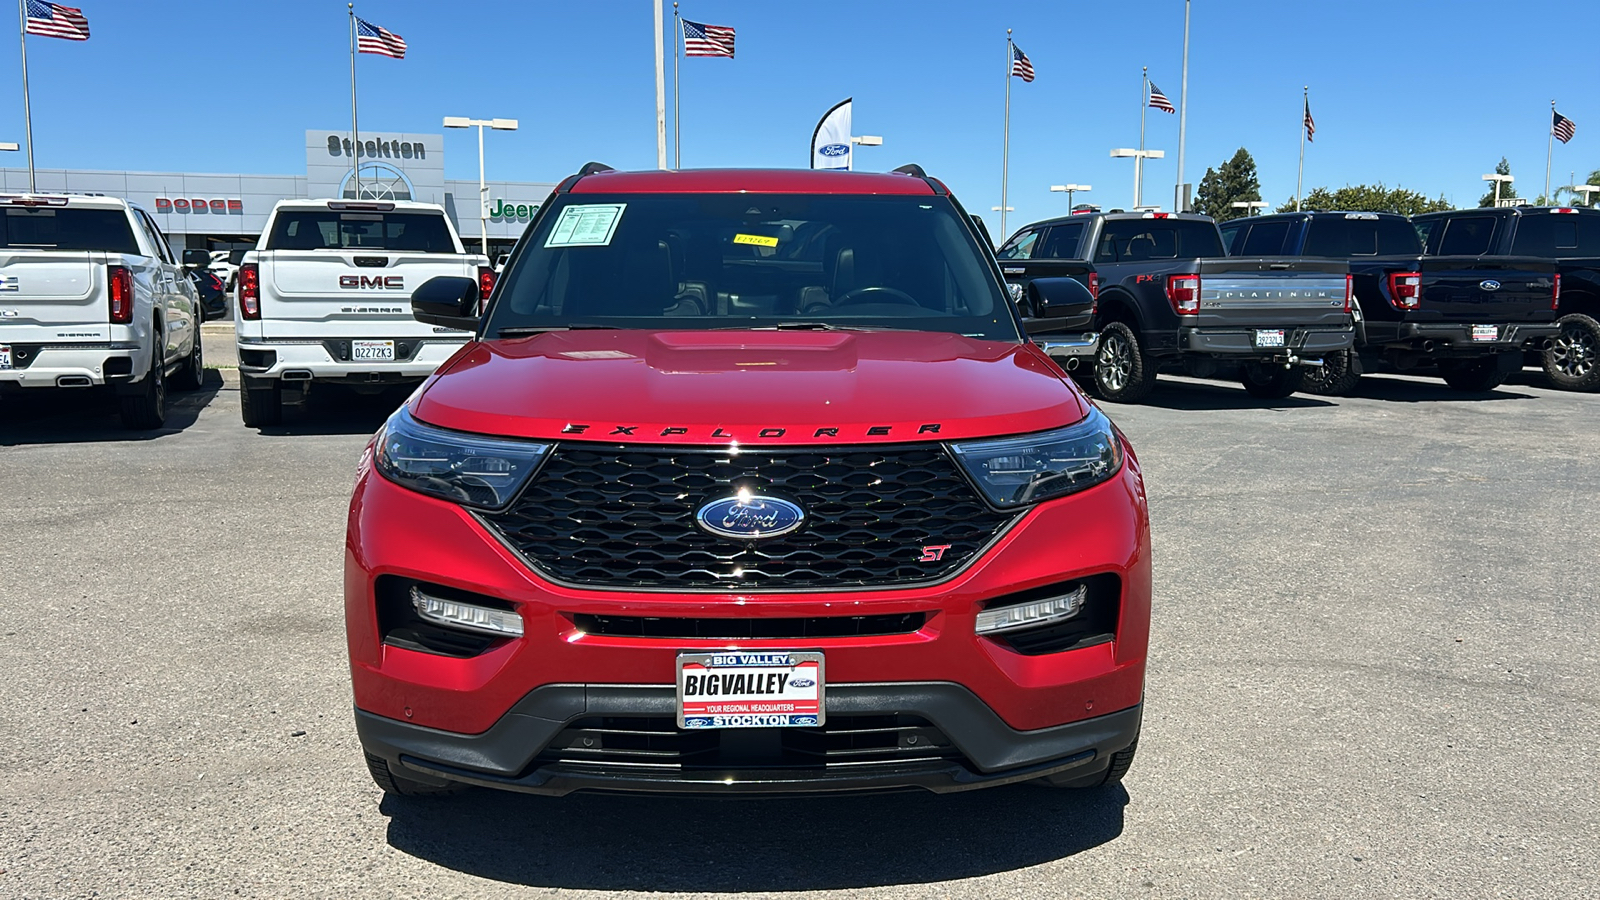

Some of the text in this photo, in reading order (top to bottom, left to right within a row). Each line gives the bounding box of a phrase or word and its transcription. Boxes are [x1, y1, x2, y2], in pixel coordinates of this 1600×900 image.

[327, 135, 426, 158] Stockton
[824, 145, 846, 156] Ford
[155, 198, 243, 210] DODGE
[339, 275, 405, 289] GMC
[1136, 274, 1161, 284] FX4
[355, 347, 392, 358] 02272K3
[560, 422, 942, 438] EXPLORER
[722, 502, 779, 528] Ford
[919, 544, 952, 562] ST
[713, 655, 789, 665] BIG VALLEY
[684, 673, 813, 696] BIGVALLEY Ford
[706, 703, 795, 713] YOUR REGIONAL HEADQUARTERS
[713, 715, 790, 726] STOCKTON
